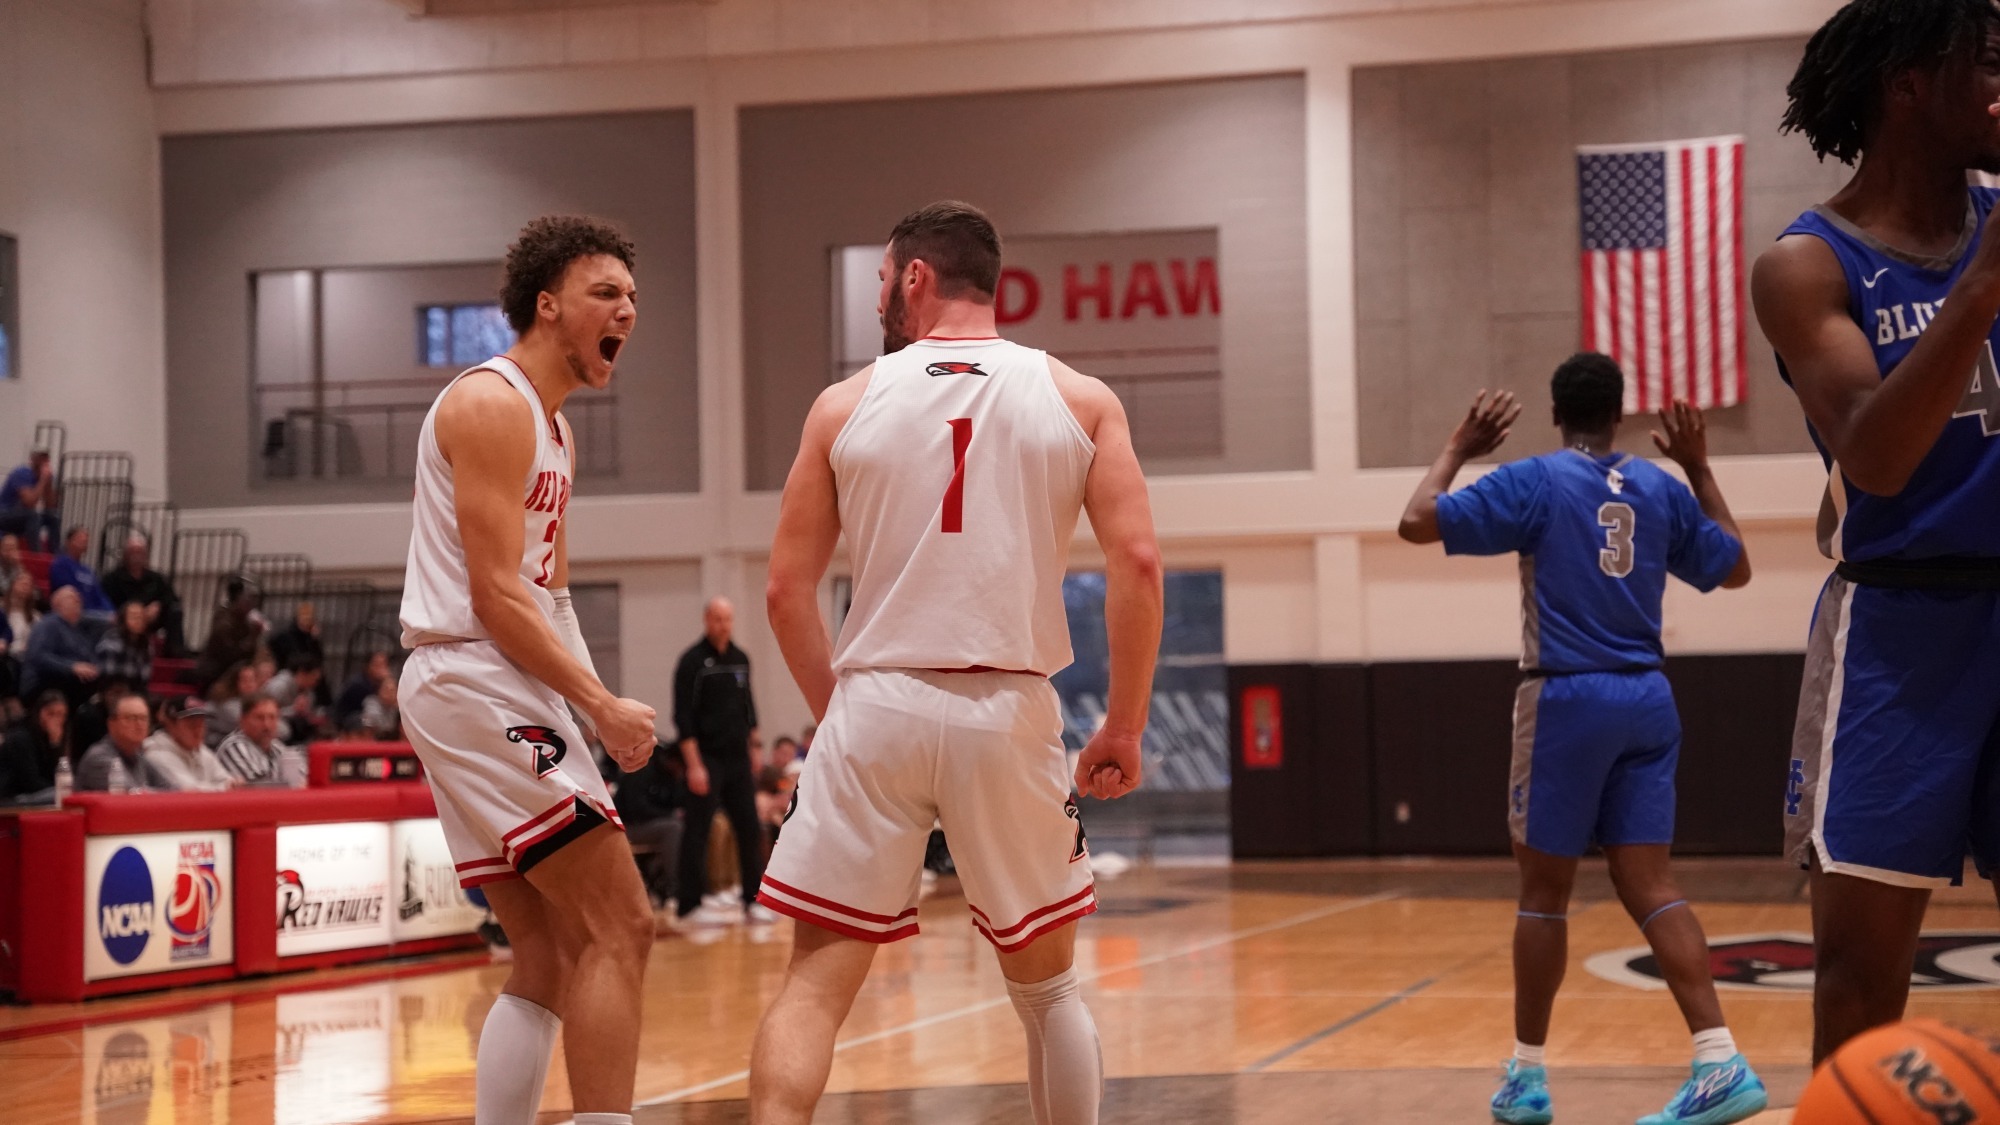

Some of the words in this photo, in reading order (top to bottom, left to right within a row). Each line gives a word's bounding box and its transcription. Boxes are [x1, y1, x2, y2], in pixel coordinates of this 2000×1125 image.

[1875, 297, 1947, 345] BLU
[940, 417, 973, 533] 1
[1597, 501, 1635, 578] 3
[101, 902, 154, 939] NCAA
[1879, 1047, 1978, 1125] NCA
